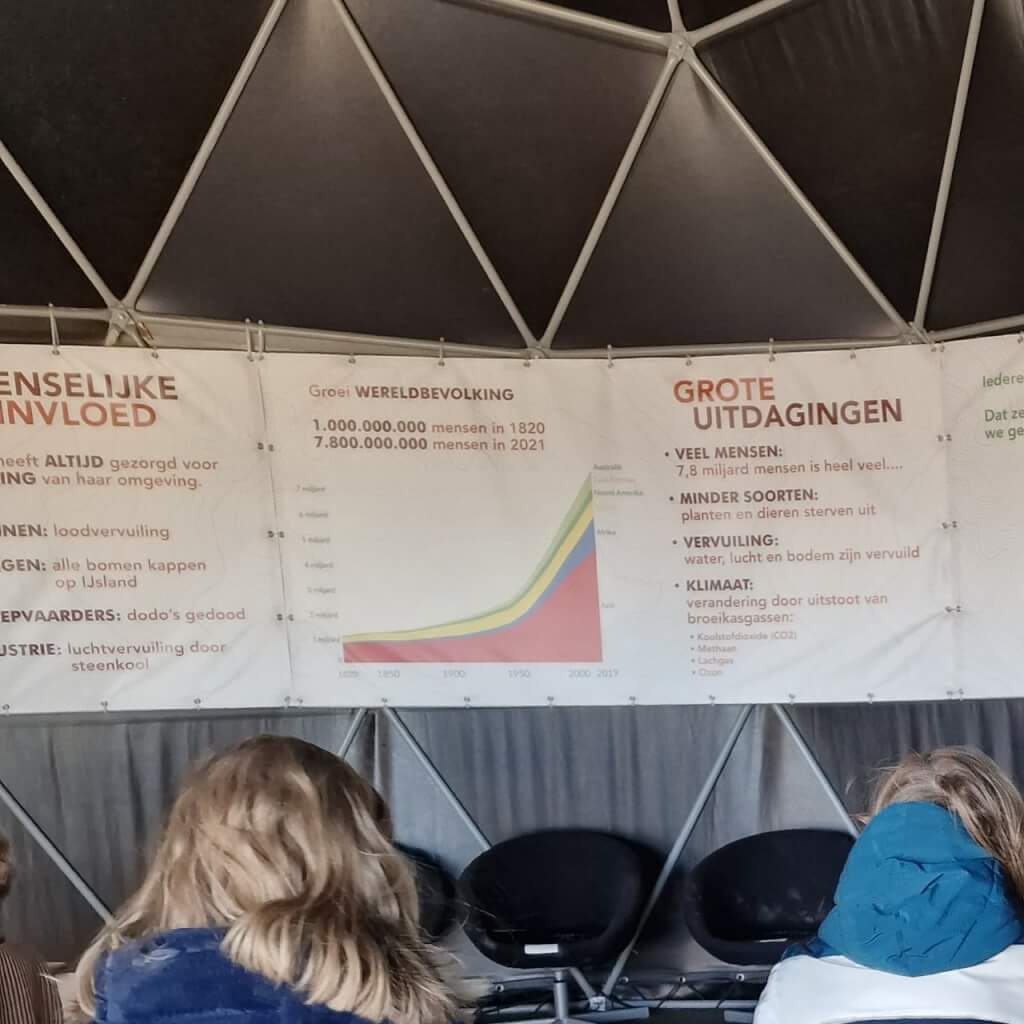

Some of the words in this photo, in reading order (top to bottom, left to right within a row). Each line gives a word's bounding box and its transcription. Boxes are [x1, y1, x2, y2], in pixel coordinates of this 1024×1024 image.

[309, 385, 350, 398] Groei
[356, 386, 514, 401] WERELDBEVOLKING
[674, 377, 775, 403] GROTE
[0, 401, 156, 427] INVLOED
[693, 399, 902, 430] UITDAGINGEN
[985, 409, 1007, 422] Dat
[313, 419, 426, 433] 1.000.000.000
[432, 422, 487, 434] mensen
[493, 422, 505, 434] in
[510, 422, 545, 434] 1820
[985, 427, 1003, 439] we
[314, 436, 427, 450] 7.800.000.000
[433, 439, 488, 450] mensen
[493, 439, 506, 451] in
[511, 438, 545, 451] 2021
[675, 448, 710, 460] VEEL
[715, 445, 782, 459] MENSEN:
[45, 455, 104, 469] ALTIJD
[110, 457, 177, 473] gezorgd
[182, 460, 219, 470] voor
[677, 464, 697, 479] 7,8
[702, 463, 749, 479] miljard
[754, 463, 805, 475] mensen
[810, 461, 820, 472] is
[824, 459, 853, 472] heel
[42, 474, 70, 485] van
[76, 473, 111, 486] haar
[118, 474, 202, 490] omgeving.
[680, 492, 739, 504] MINDER
[744, 489, 818, 502] SOORTEN:
[682, 508, 731, 523] planten
[736, 510, 752, 520] en
[757, 506, 799, 519] dieren
[804, 507, 853, 517] sterven
[858, 505, 876, 516] uit
[54, 525, 170, 541] loodvervuiling
[683, 535, 779, 548] VERVUILING:
[684, 554, 726, 565] water,
[730, 551, 762, 564] lucht
[766, 553, 782, 562] en
[787, 550, 834, 562] bodem
[839, 549, 861, 563] zijn
[866, 546, 919, 559] vervuild
[52, 559, 80, 571] alle
[87, 560, 142, 572] bomen
[148, 559, 207, 574] kappen
[55, 578, 76, 590] op
[82, 576, 137, 588] IJsland
[686, 579, 753, 591] KLIMAAT:
[127, 609, 181, 621] dodo's
[186, 609, 246, 623] gedood
[688, 612, 793, 625] broeikasgassen:
